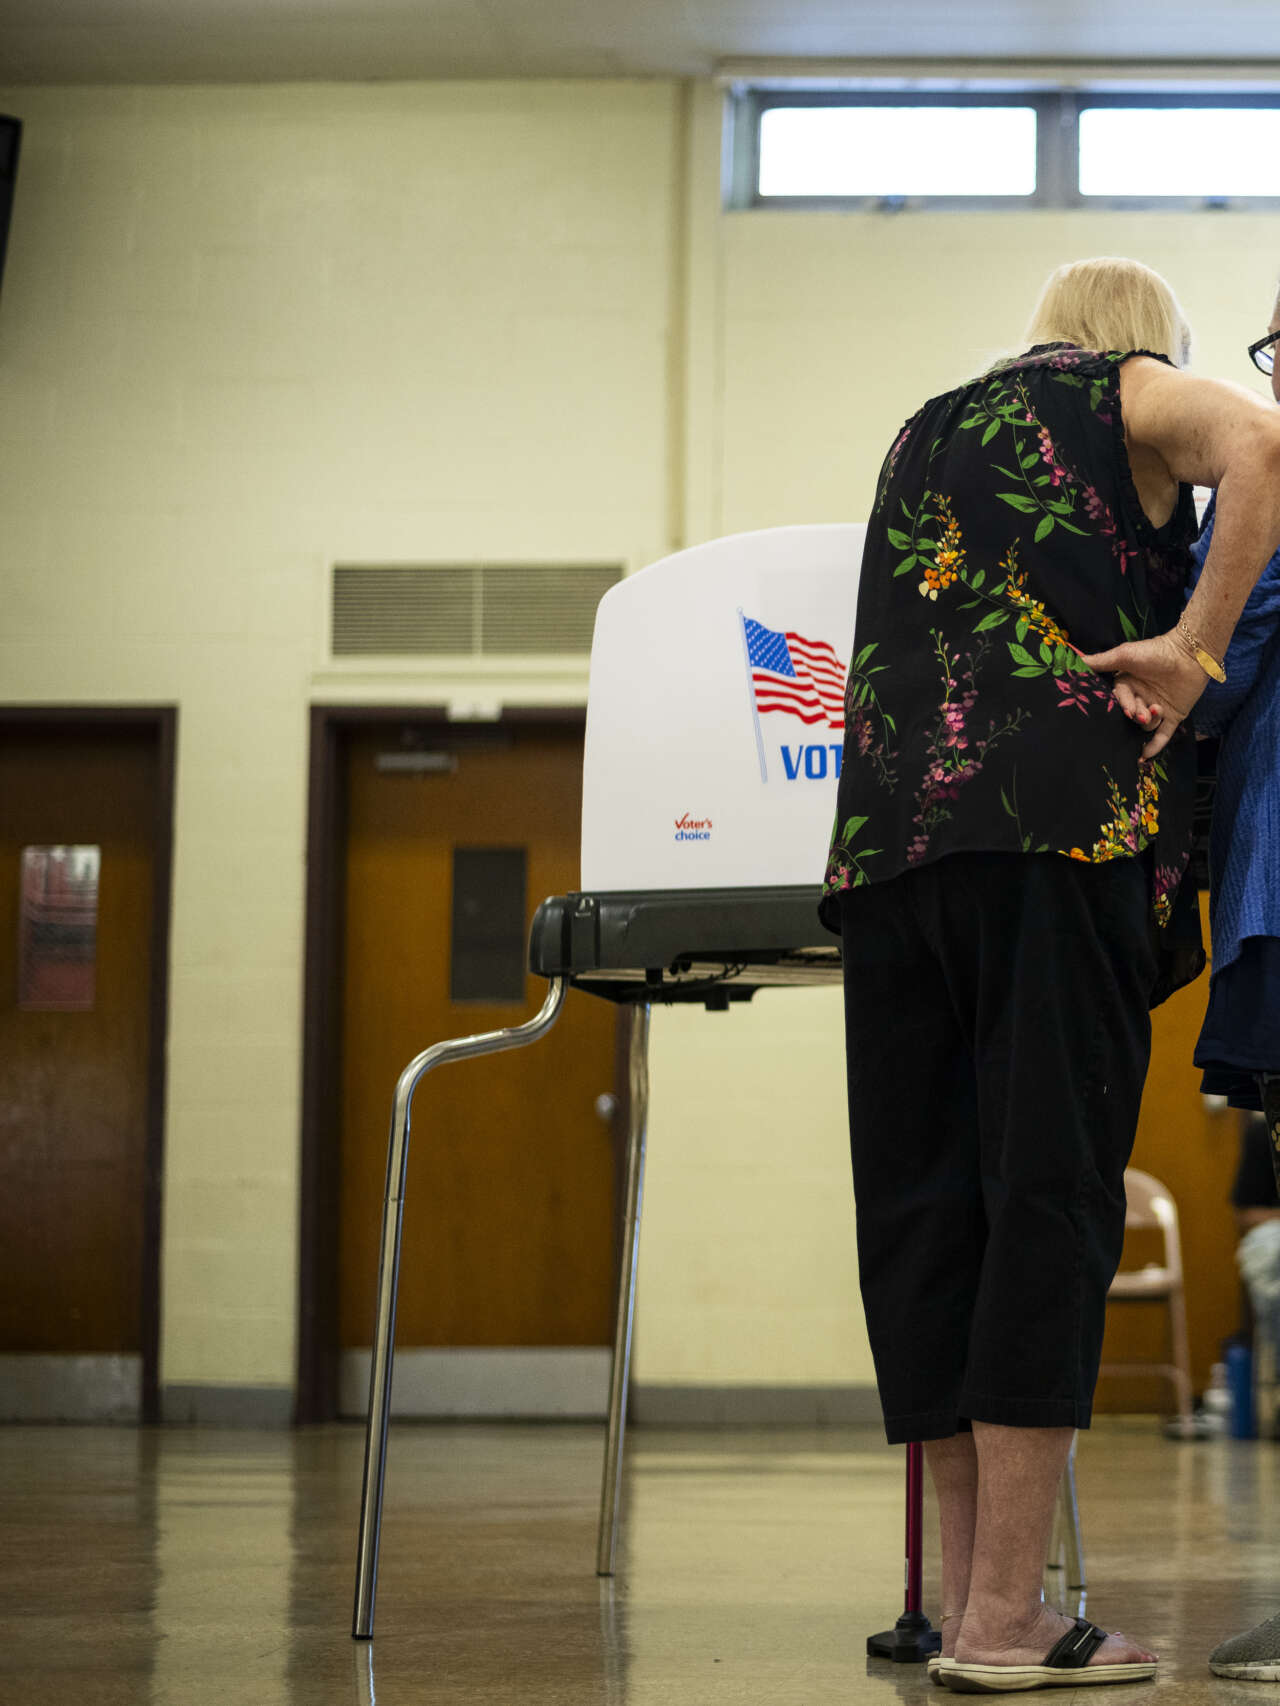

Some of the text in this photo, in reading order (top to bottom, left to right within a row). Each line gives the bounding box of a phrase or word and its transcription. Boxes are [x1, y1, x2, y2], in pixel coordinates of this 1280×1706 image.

[780, 744, 844, 780] VOT
[675, 812, 712, 830] Voter's
[675, 830, 711, 841] choice
